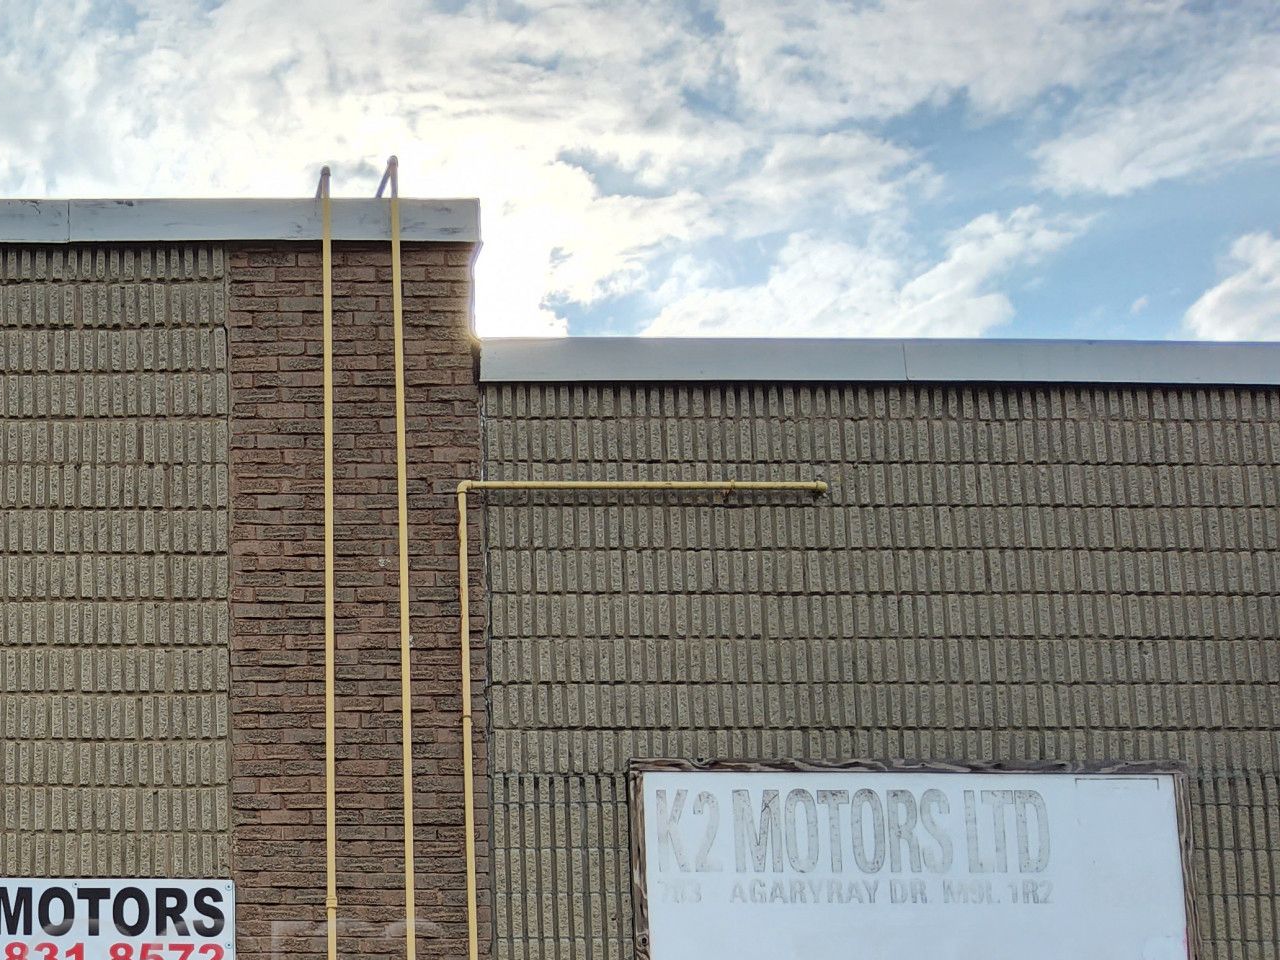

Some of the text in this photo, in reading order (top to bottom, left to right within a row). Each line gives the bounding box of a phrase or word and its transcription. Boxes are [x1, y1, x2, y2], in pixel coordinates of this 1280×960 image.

[655, 788, 1051, 873] K2 MOTORS LTD
